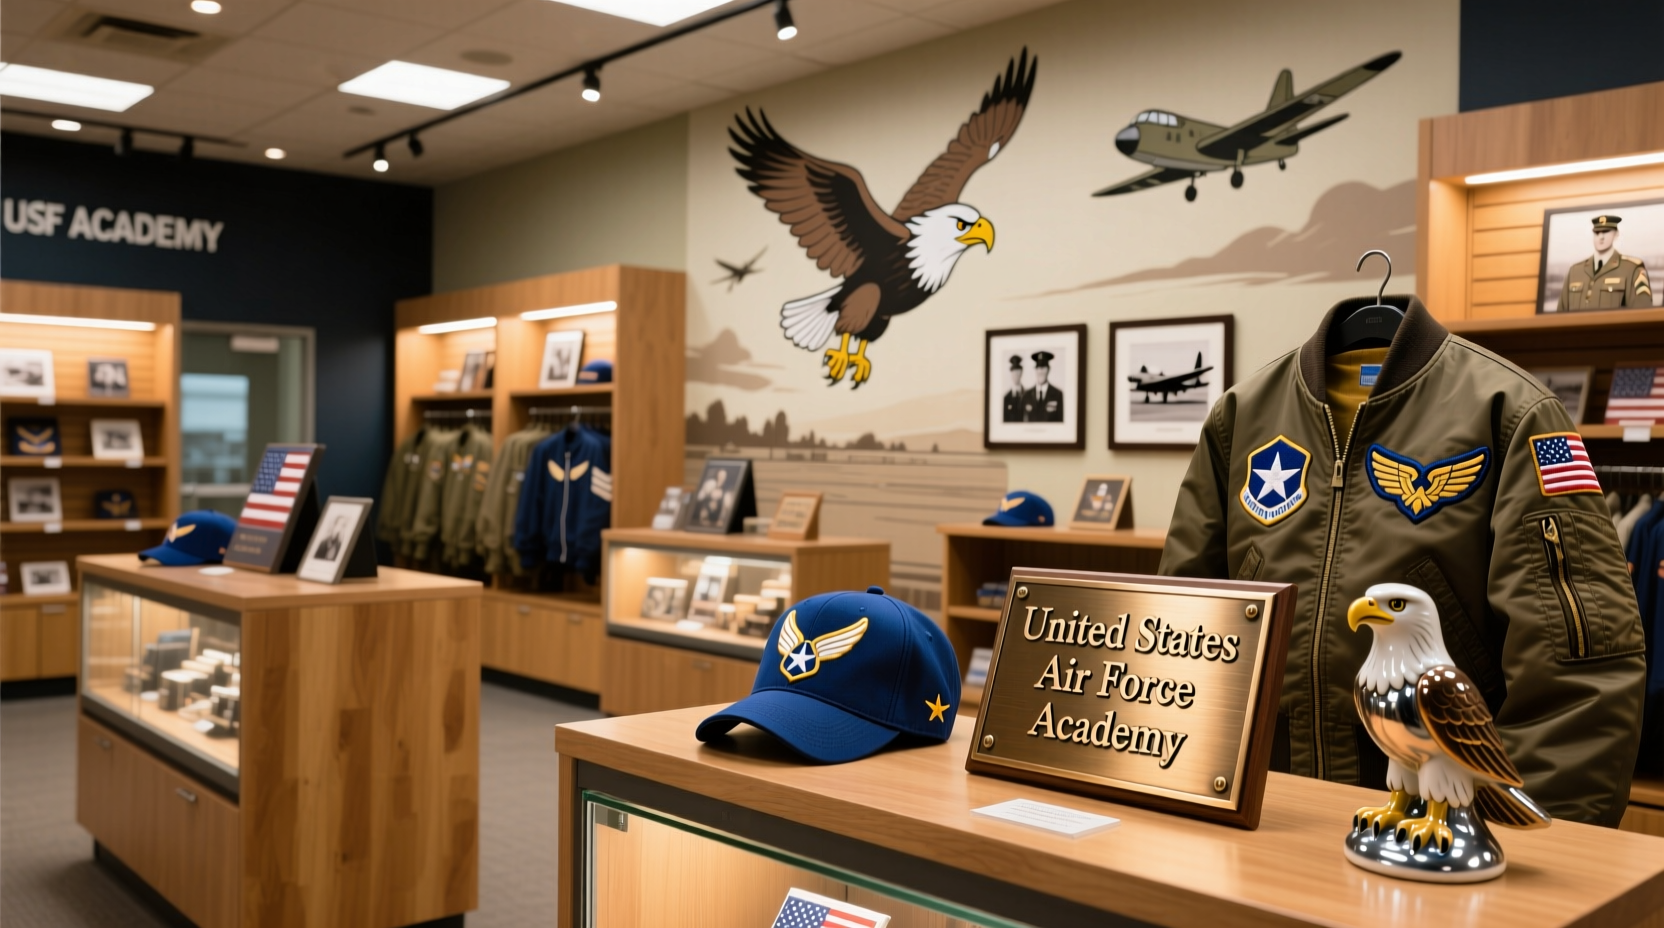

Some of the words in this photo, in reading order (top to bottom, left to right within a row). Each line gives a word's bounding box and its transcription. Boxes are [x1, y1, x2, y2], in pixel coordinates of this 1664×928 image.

[3, 198, 66, 236] USF
[67, 205, 225, 253] ACADEMY
[1023, 606, 1129, 649] United
[1134, 615, 1239, 662] States
[1034, 654, 1092, 694] Air
[1096, 661, 1195, 708] Force
[1027, 702, 1187, 769] Academy
